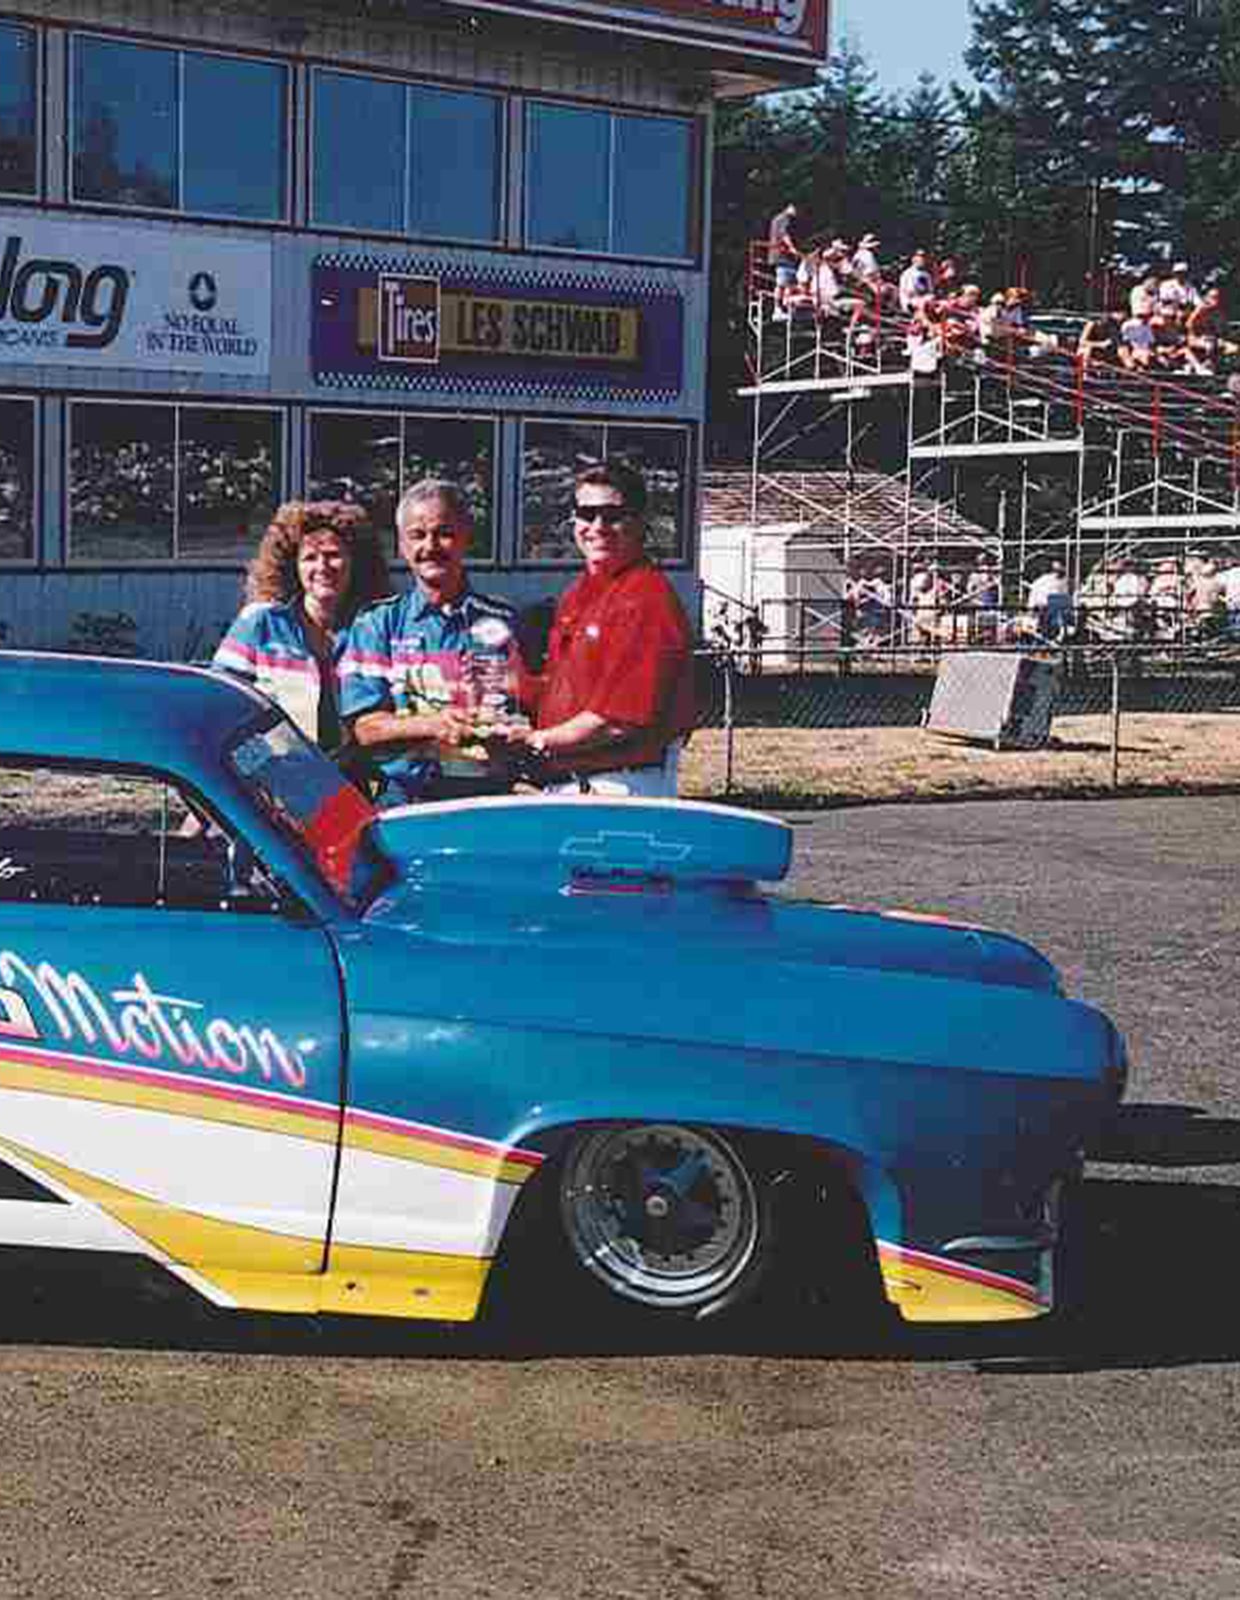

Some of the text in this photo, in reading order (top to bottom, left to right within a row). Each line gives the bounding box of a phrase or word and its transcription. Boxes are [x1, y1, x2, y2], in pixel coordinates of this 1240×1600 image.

[384, 281, 436, 353] Tires
[457, 300, 503, 347] LES
[168, 333, 200, 352] THE
[201, 336, 258, 356] WORLD
